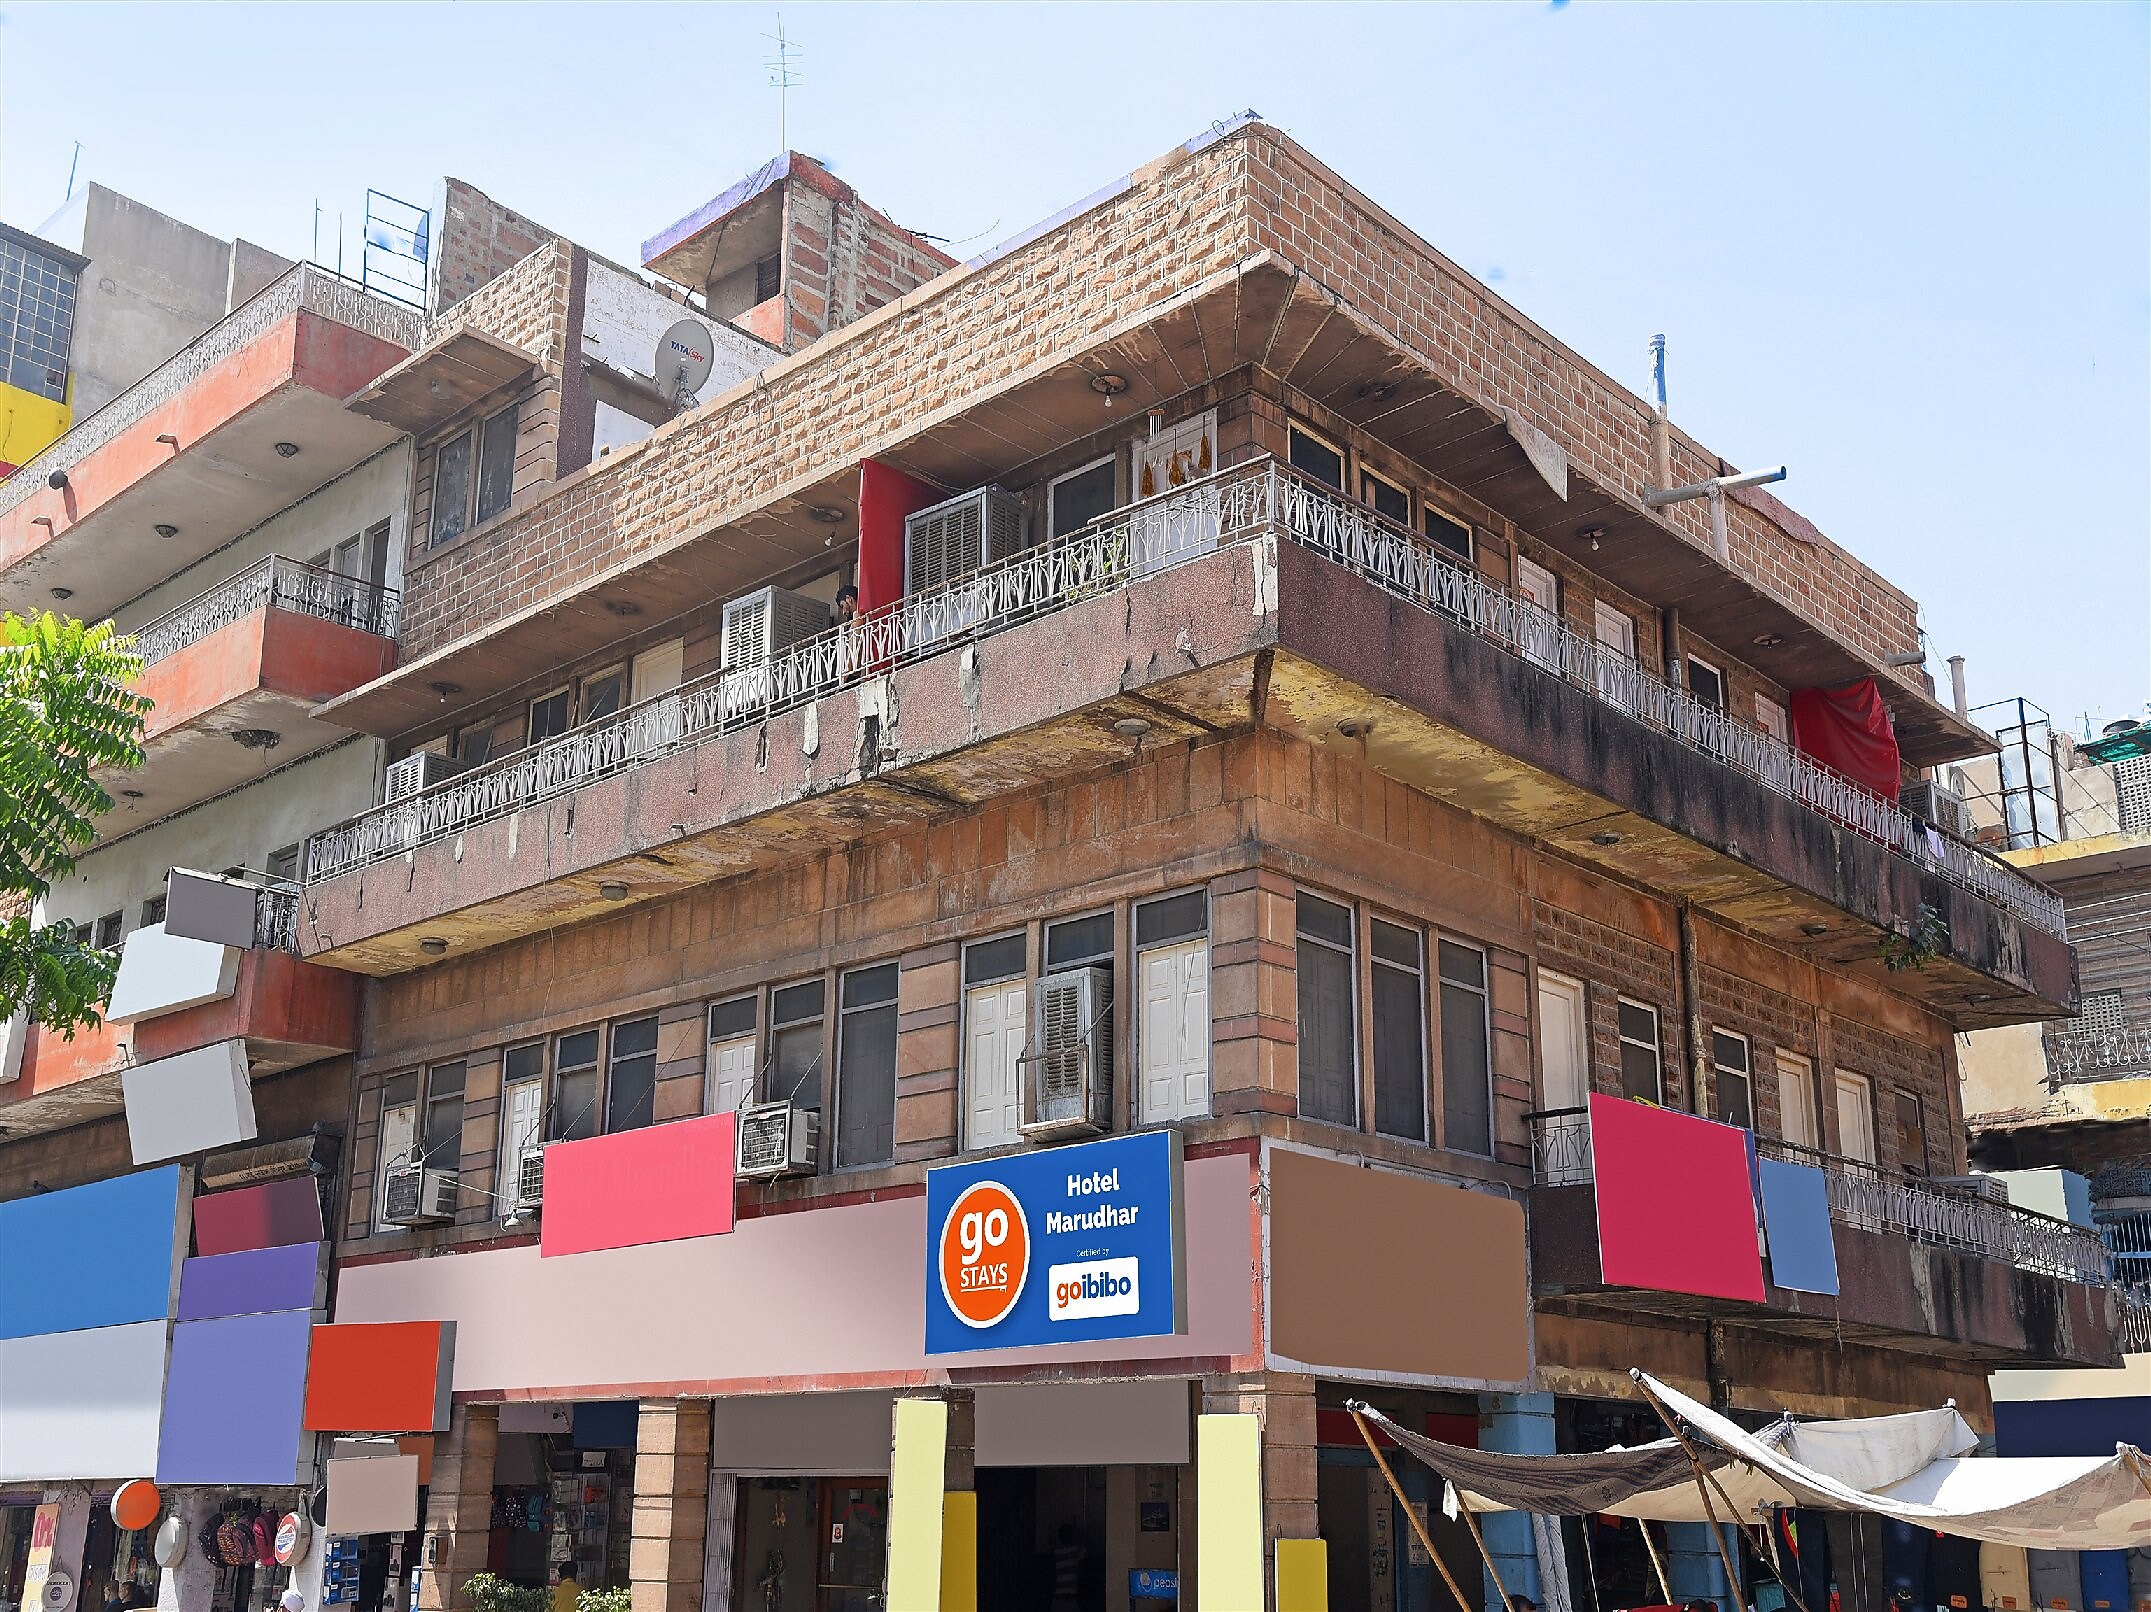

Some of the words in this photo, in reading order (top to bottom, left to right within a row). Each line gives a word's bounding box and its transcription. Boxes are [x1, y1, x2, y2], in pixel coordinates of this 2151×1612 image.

[671, 340, 689, 355] TATA
[1067, 1168, 1120, 1197] Hotel
[1046, 1204, 1139, 1235] Marudhar
[960, 1208, 1009, 1265] go
[1076, 1247, 1101, 1257] Certified
[960, 1262, 1008, 1287] STAYS
[1056, 1271, 1132, 1309] goibibo
[1153, 1577, 1177, 1590] pepsi
